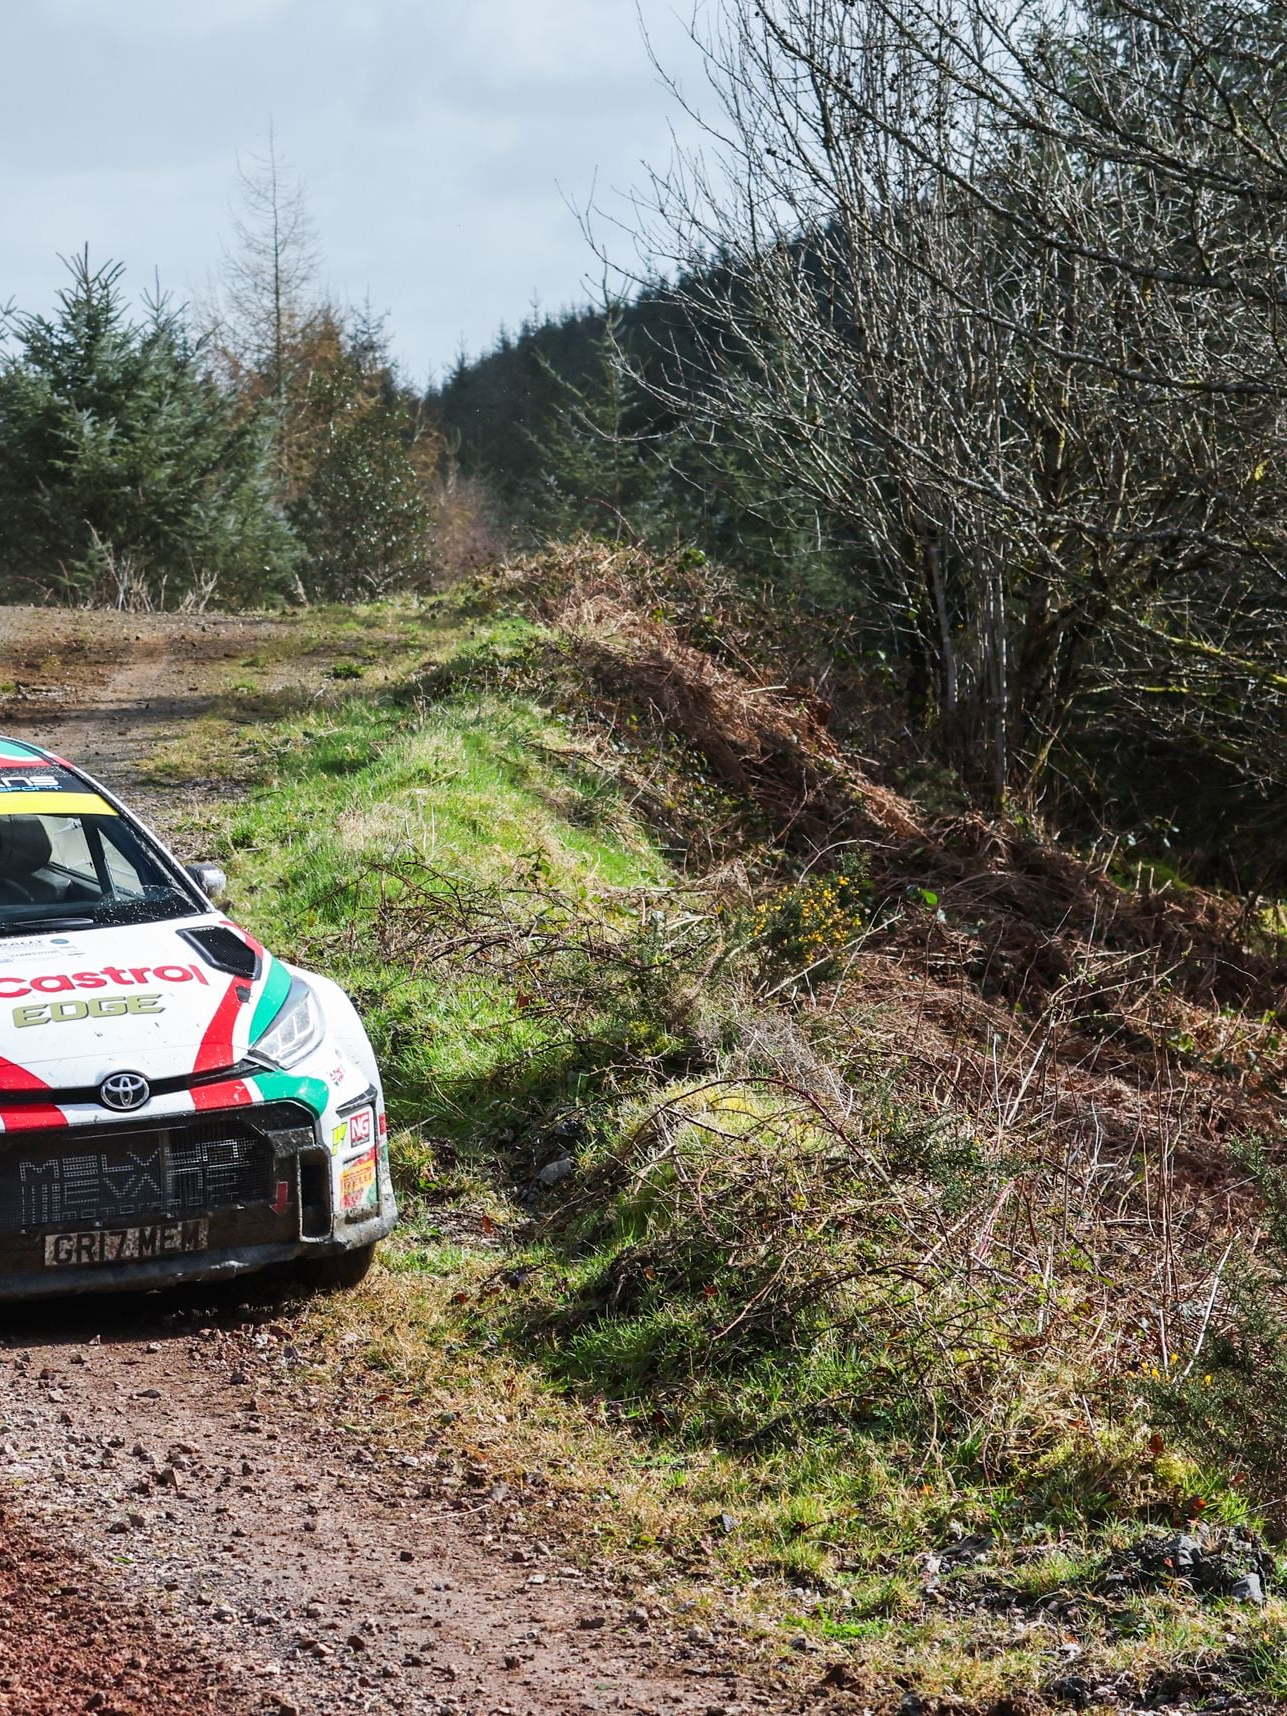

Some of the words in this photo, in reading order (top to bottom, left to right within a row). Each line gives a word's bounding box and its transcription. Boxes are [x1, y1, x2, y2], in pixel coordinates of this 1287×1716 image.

[12, 993, 165, 1029] EDGE
[351, 1114, 370, 1140] NG
[53, 1229, 128, 1265] GR17
